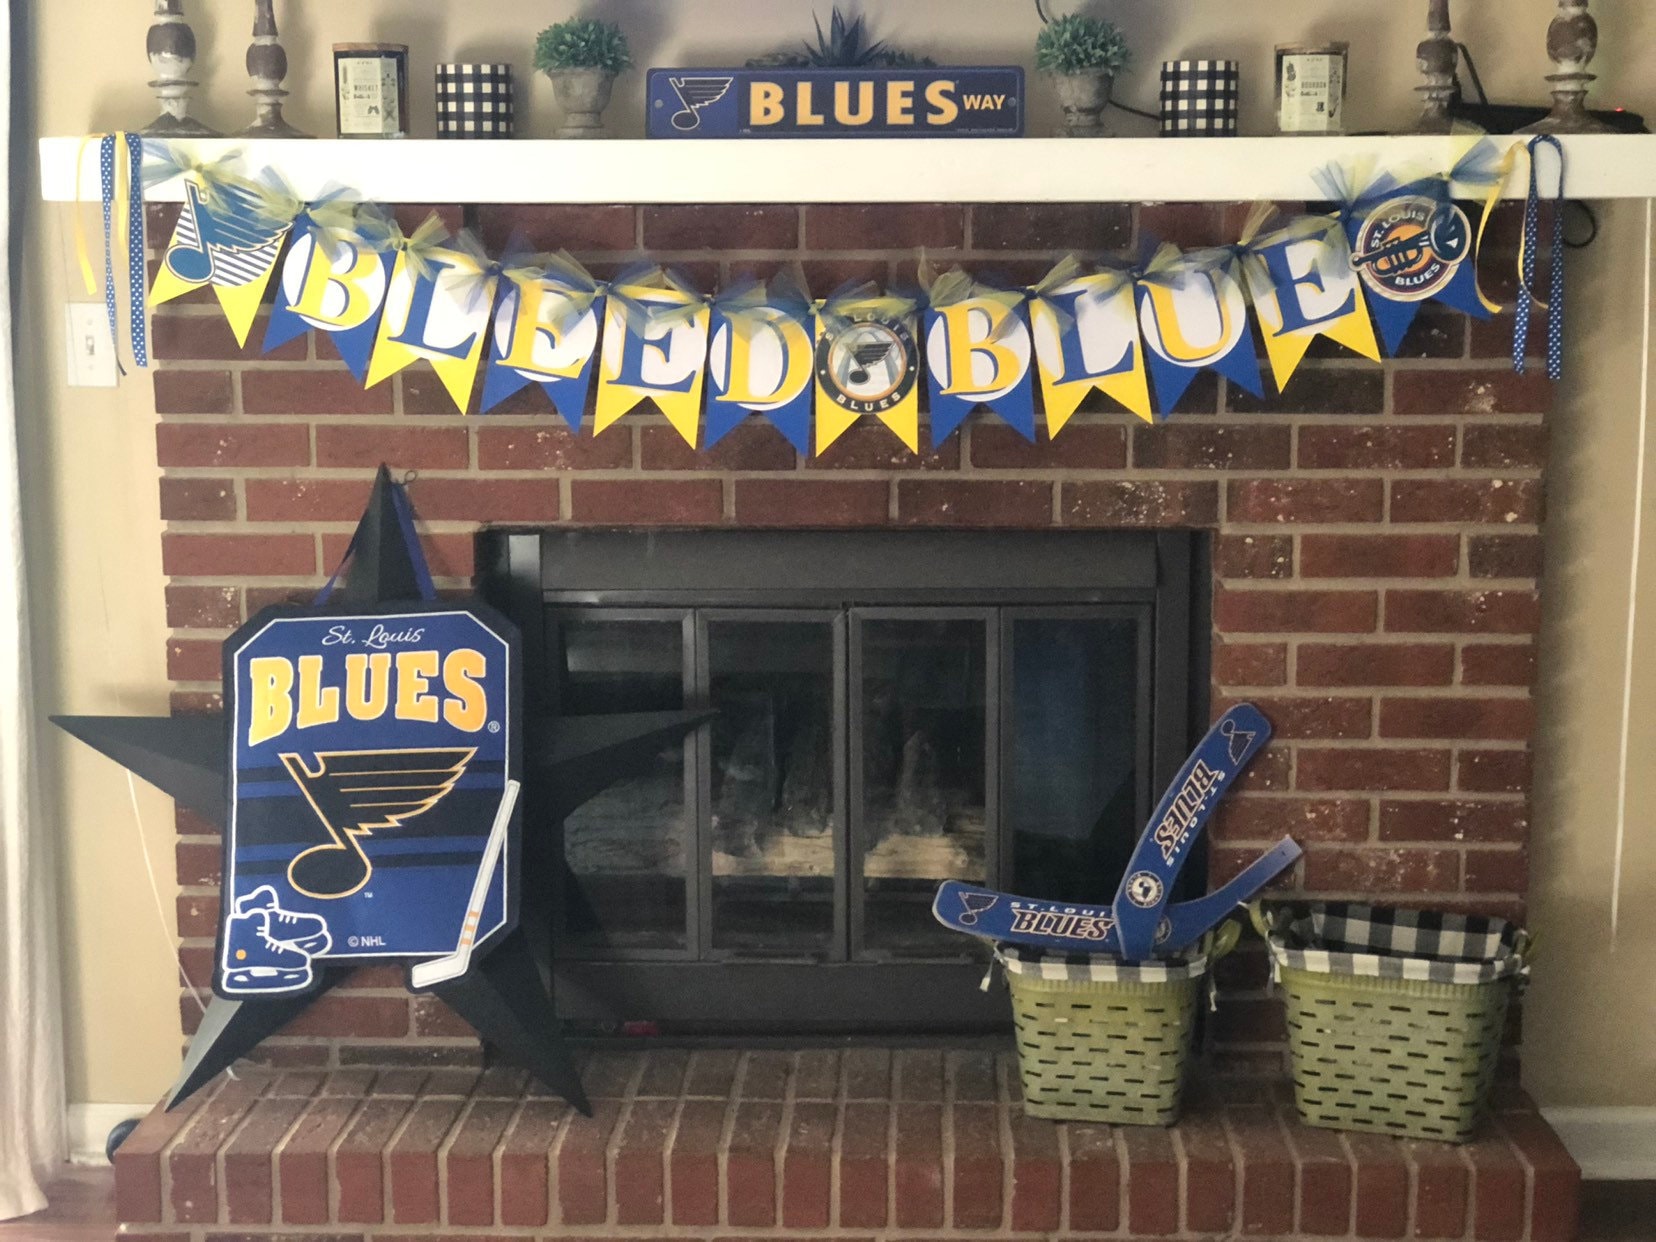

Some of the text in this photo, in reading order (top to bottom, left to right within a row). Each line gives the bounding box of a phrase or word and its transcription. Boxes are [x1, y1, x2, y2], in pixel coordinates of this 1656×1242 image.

[749, 80, 1006, 126] BLUES WAY
[1382, 209, 1426, 229] LOUIS
[1394, 262, 1441, 286] BLUES
[934, 230, 1357, 396] BLUE
[836, 391, 901, 412] BLUES
[321, 623, 425, 650] St. Louis
[248, 648, 488, 746] BLUES
[1154, 759, 1220, 860] BLUES
[1010, 908, 1117, 941] BLUES
[1049, 906, 1105, 917] LOUI
[360, 935, 387, 947] NHL
